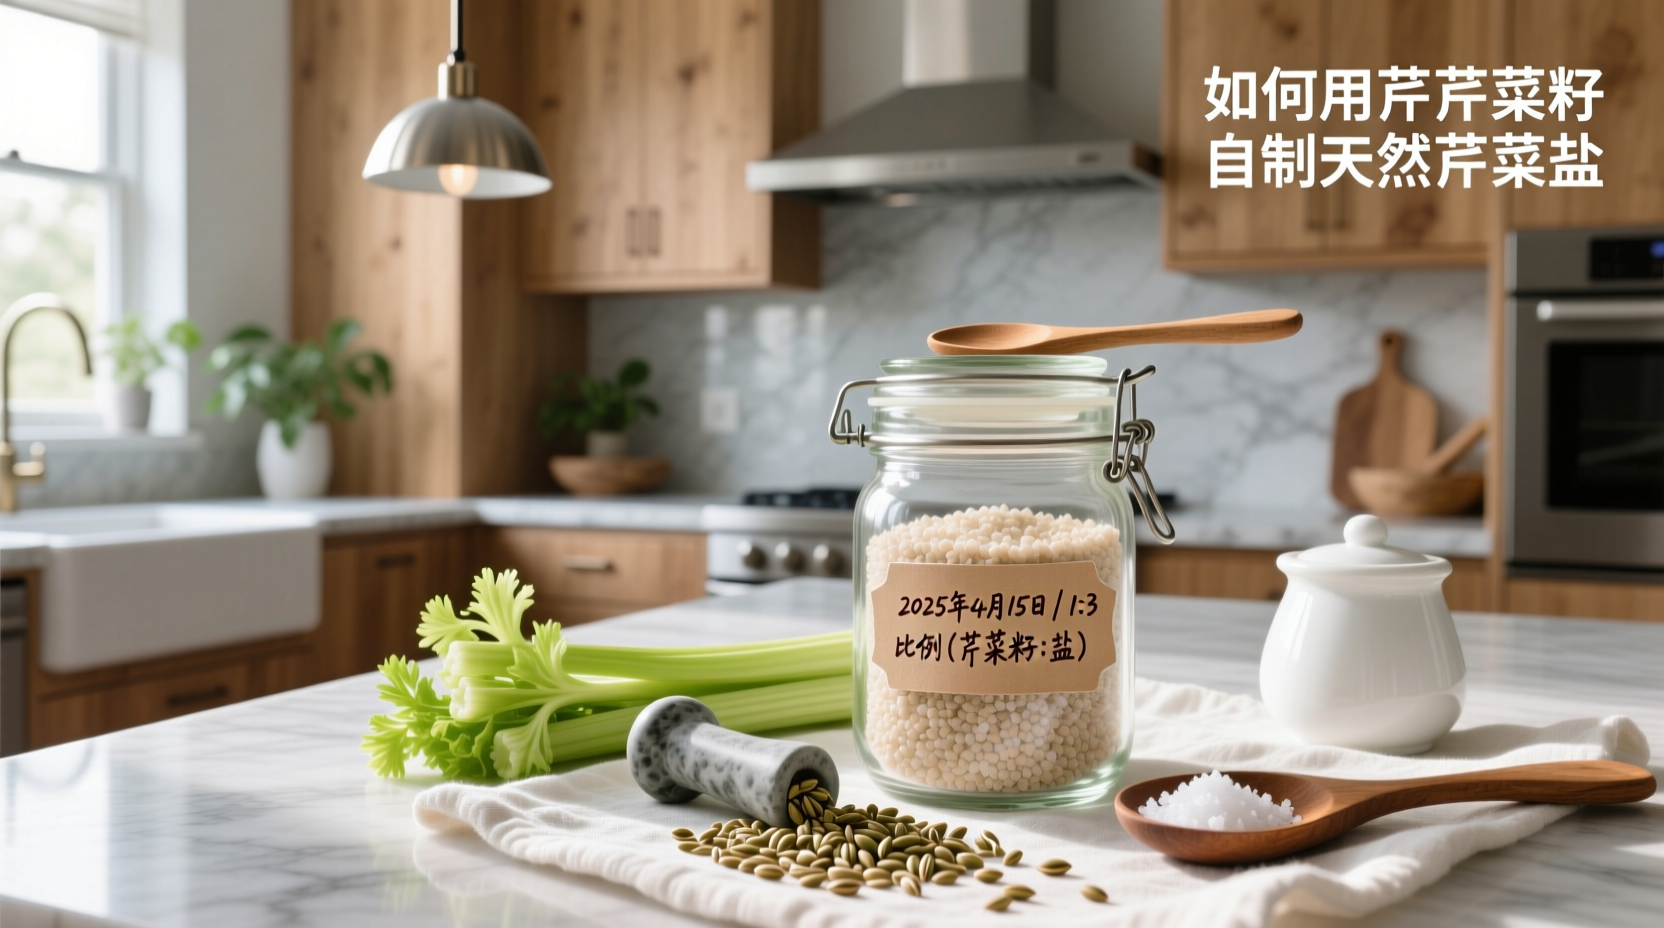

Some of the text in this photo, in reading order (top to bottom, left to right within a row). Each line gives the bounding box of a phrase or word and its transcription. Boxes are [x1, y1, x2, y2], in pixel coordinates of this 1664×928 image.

[898, 590, 1046, 623] 2025年4月15日
[1069, 593, 1098, 617] 1:3
